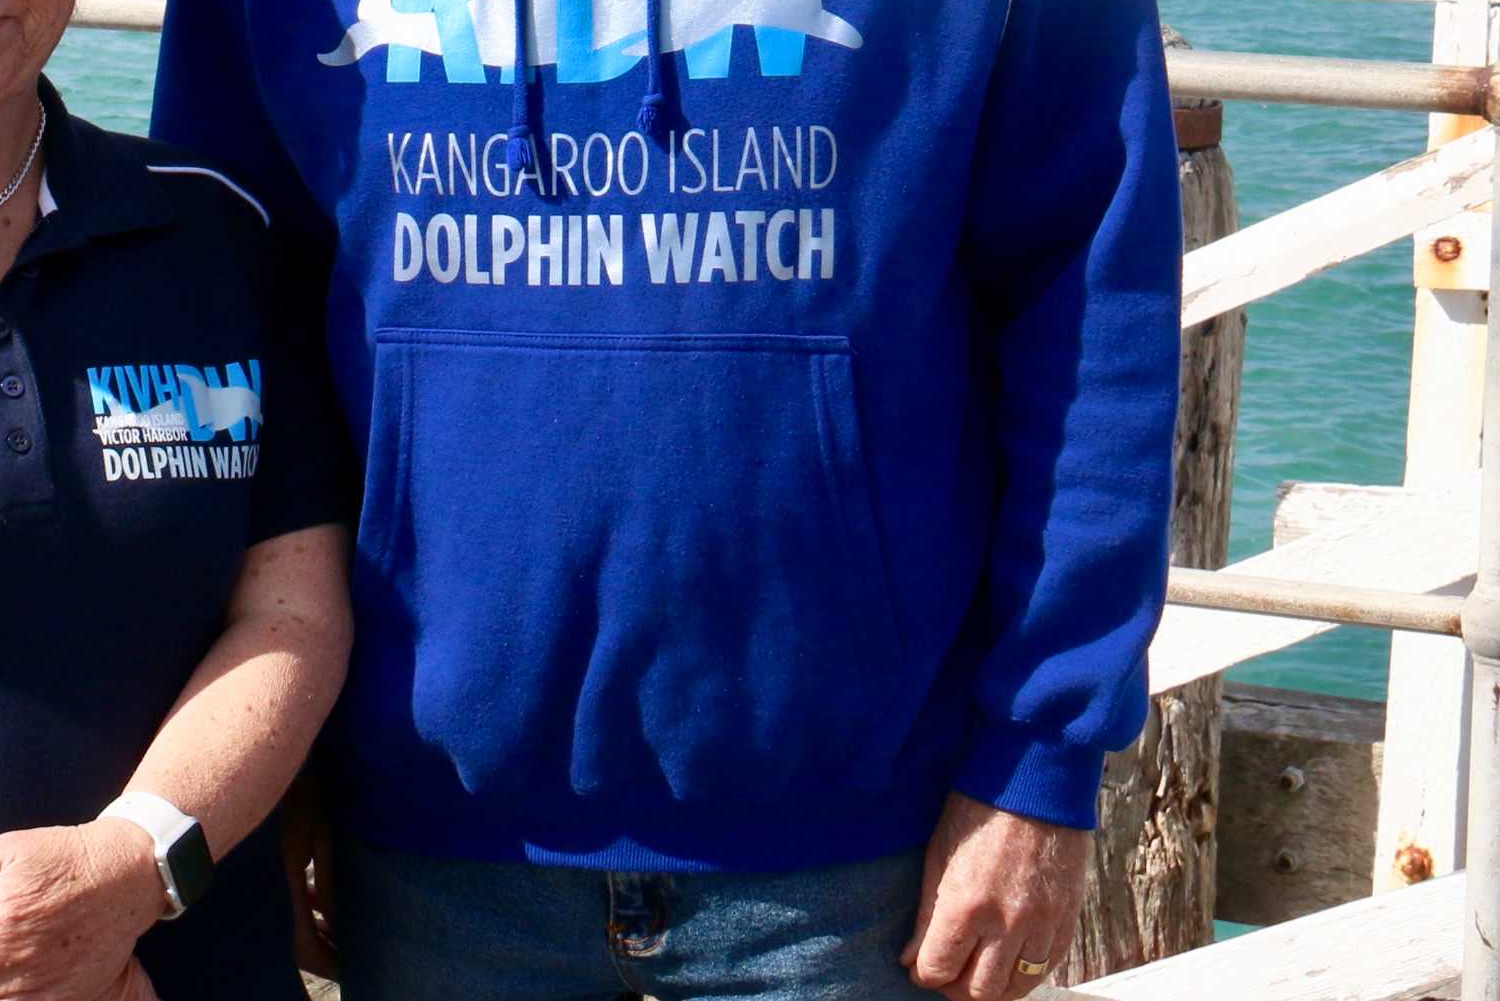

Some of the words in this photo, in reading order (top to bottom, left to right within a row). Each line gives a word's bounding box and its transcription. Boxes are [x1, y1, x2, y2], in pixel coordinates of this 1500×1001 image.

[388, 131, 649, 197] KANGAROO
[668, 125, 838, 194] ISLAND
[392, 211, 624, 286] DOLPHIN
[641, 208, 835, 283] WATCH
[100, 428, 140, 445] VICTOR
[142, 426, 188, 443] HARBOR
[103, 445, 209, 482] DOLPHIN
